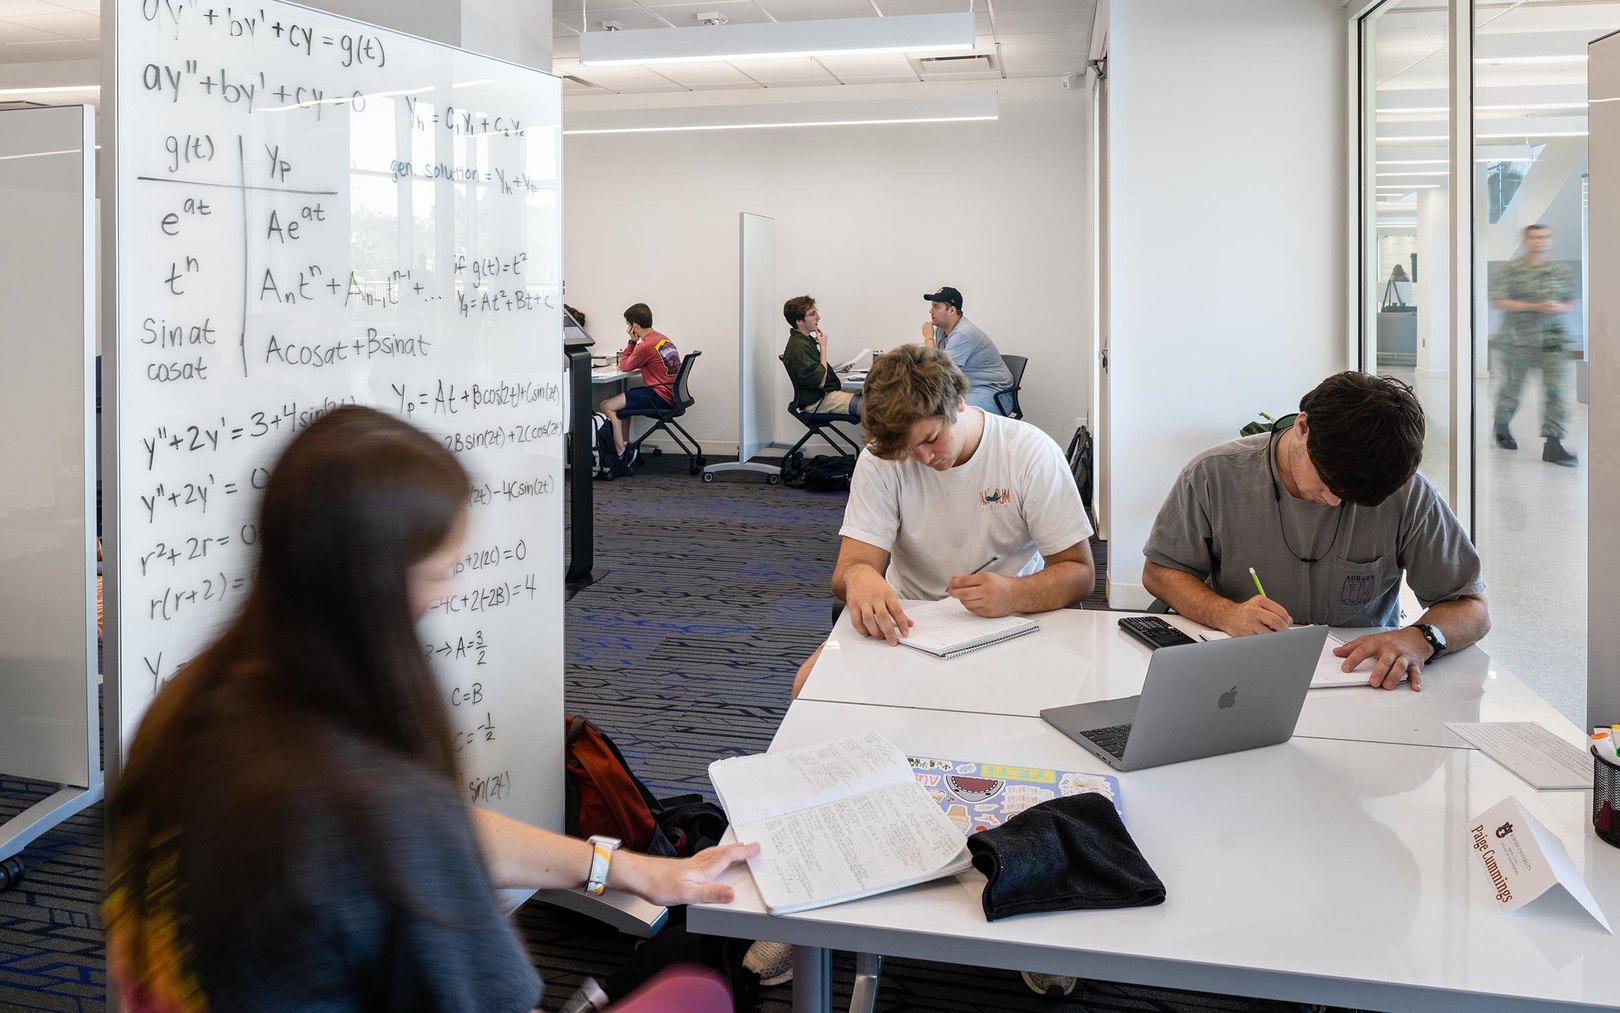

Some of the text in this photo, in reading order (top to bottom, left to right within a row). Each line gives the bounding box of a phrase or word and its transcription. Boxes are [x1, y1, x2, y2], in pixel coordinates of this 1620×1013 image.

[425, 163, 479, 182] solution
[1471, 824, 1490, 852] Paige
[1482, 849, 1513, 904] Cummings
